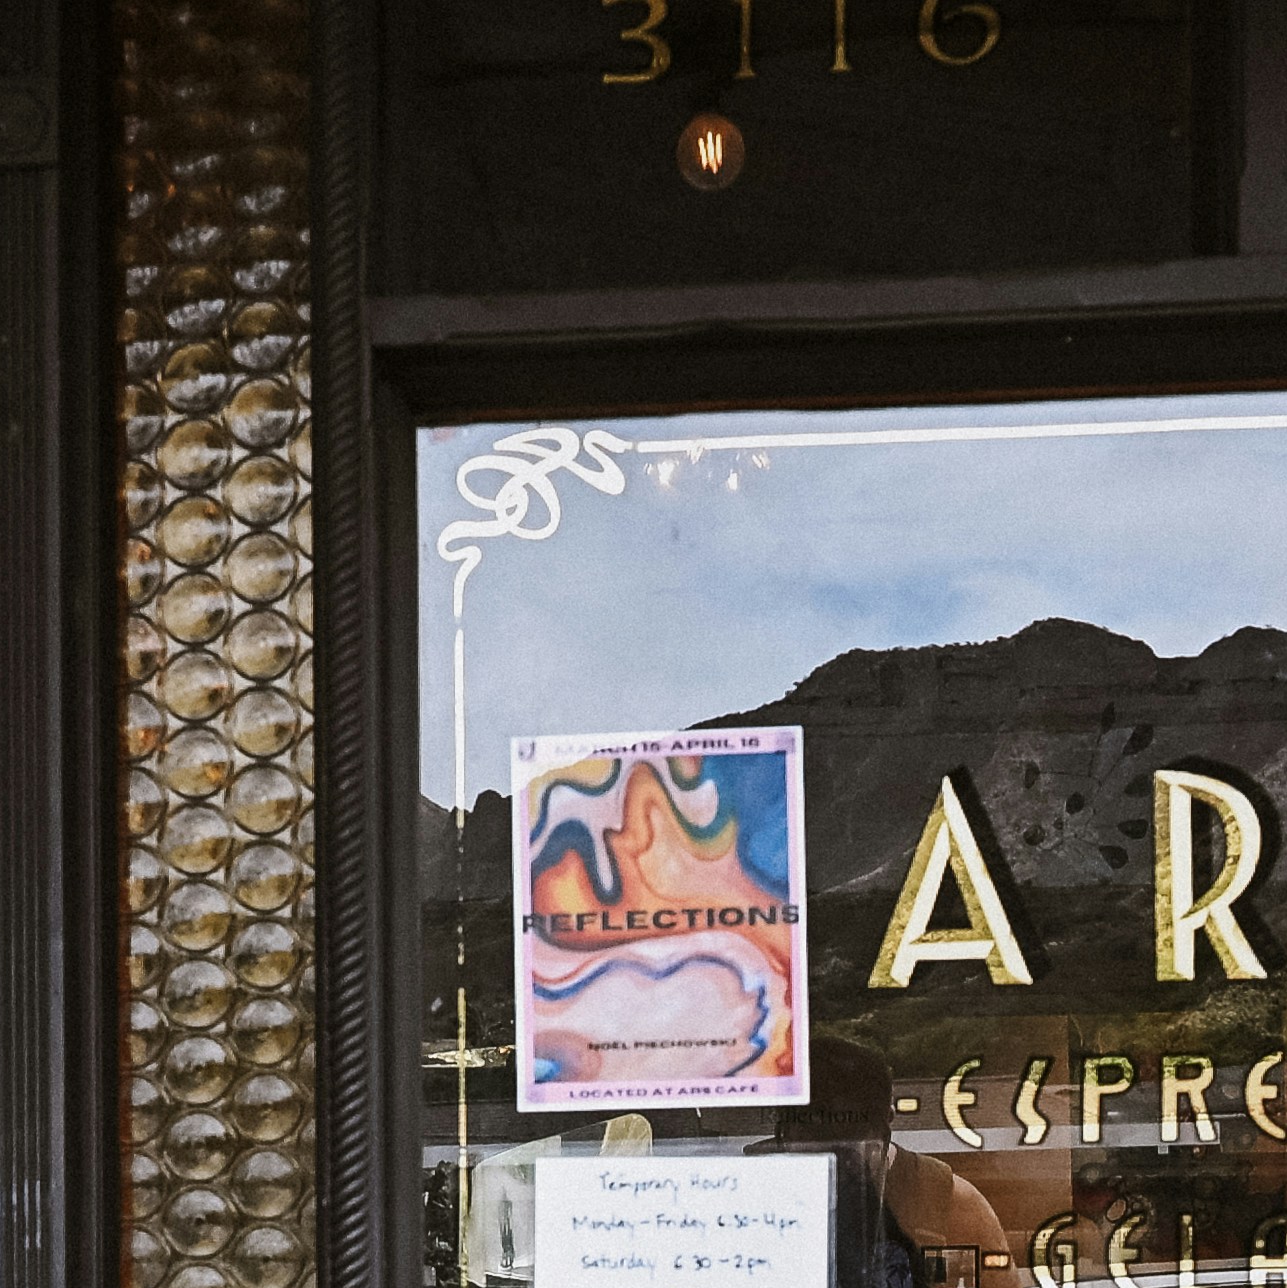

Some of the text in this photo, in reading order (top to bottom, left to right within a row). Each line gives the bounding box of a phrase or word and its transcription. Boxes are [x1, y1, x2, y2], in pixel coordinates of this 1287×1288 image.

[522, 904, 800, 935] REFLECTIONS
[568, 1087, 648, 1099] LOCATED
[580, 1252, 657, 1280] Saturday
